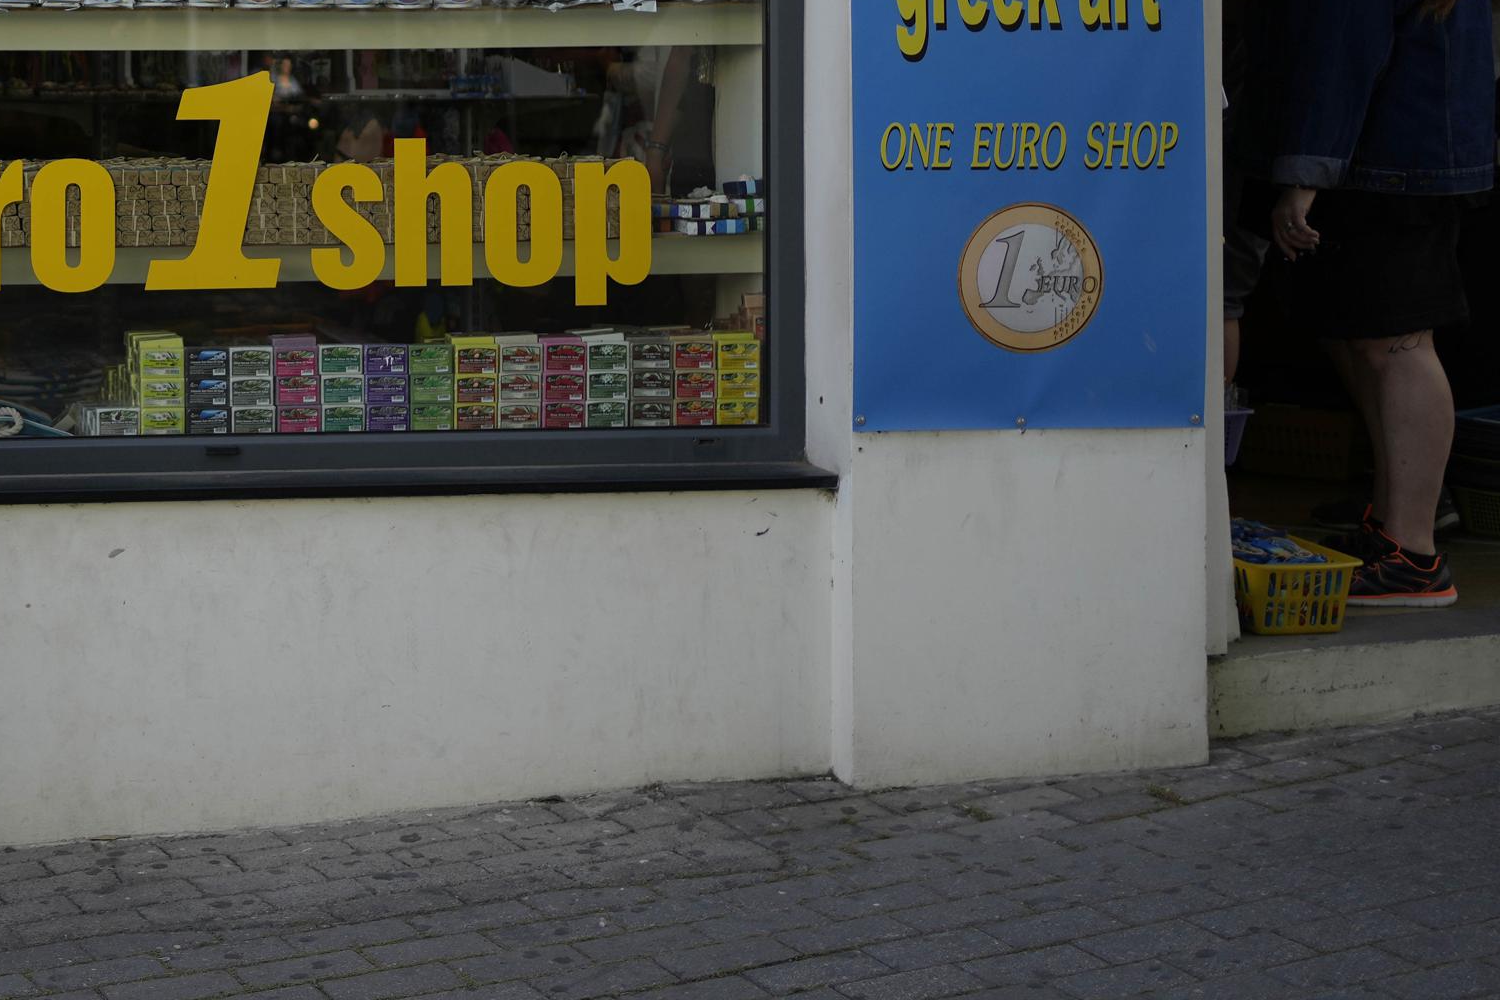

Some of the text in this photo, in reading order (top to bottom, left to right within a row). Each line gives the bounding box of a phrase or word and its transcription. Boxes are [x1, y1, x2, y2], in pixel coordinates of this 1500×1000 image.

[880, 121, 1179, 171] ONE EURO SHOP
[145, 70, 281, 290] 1
[310, 137, 653, 307] shop
[978, 230, 1097, 308] 1 EURO
